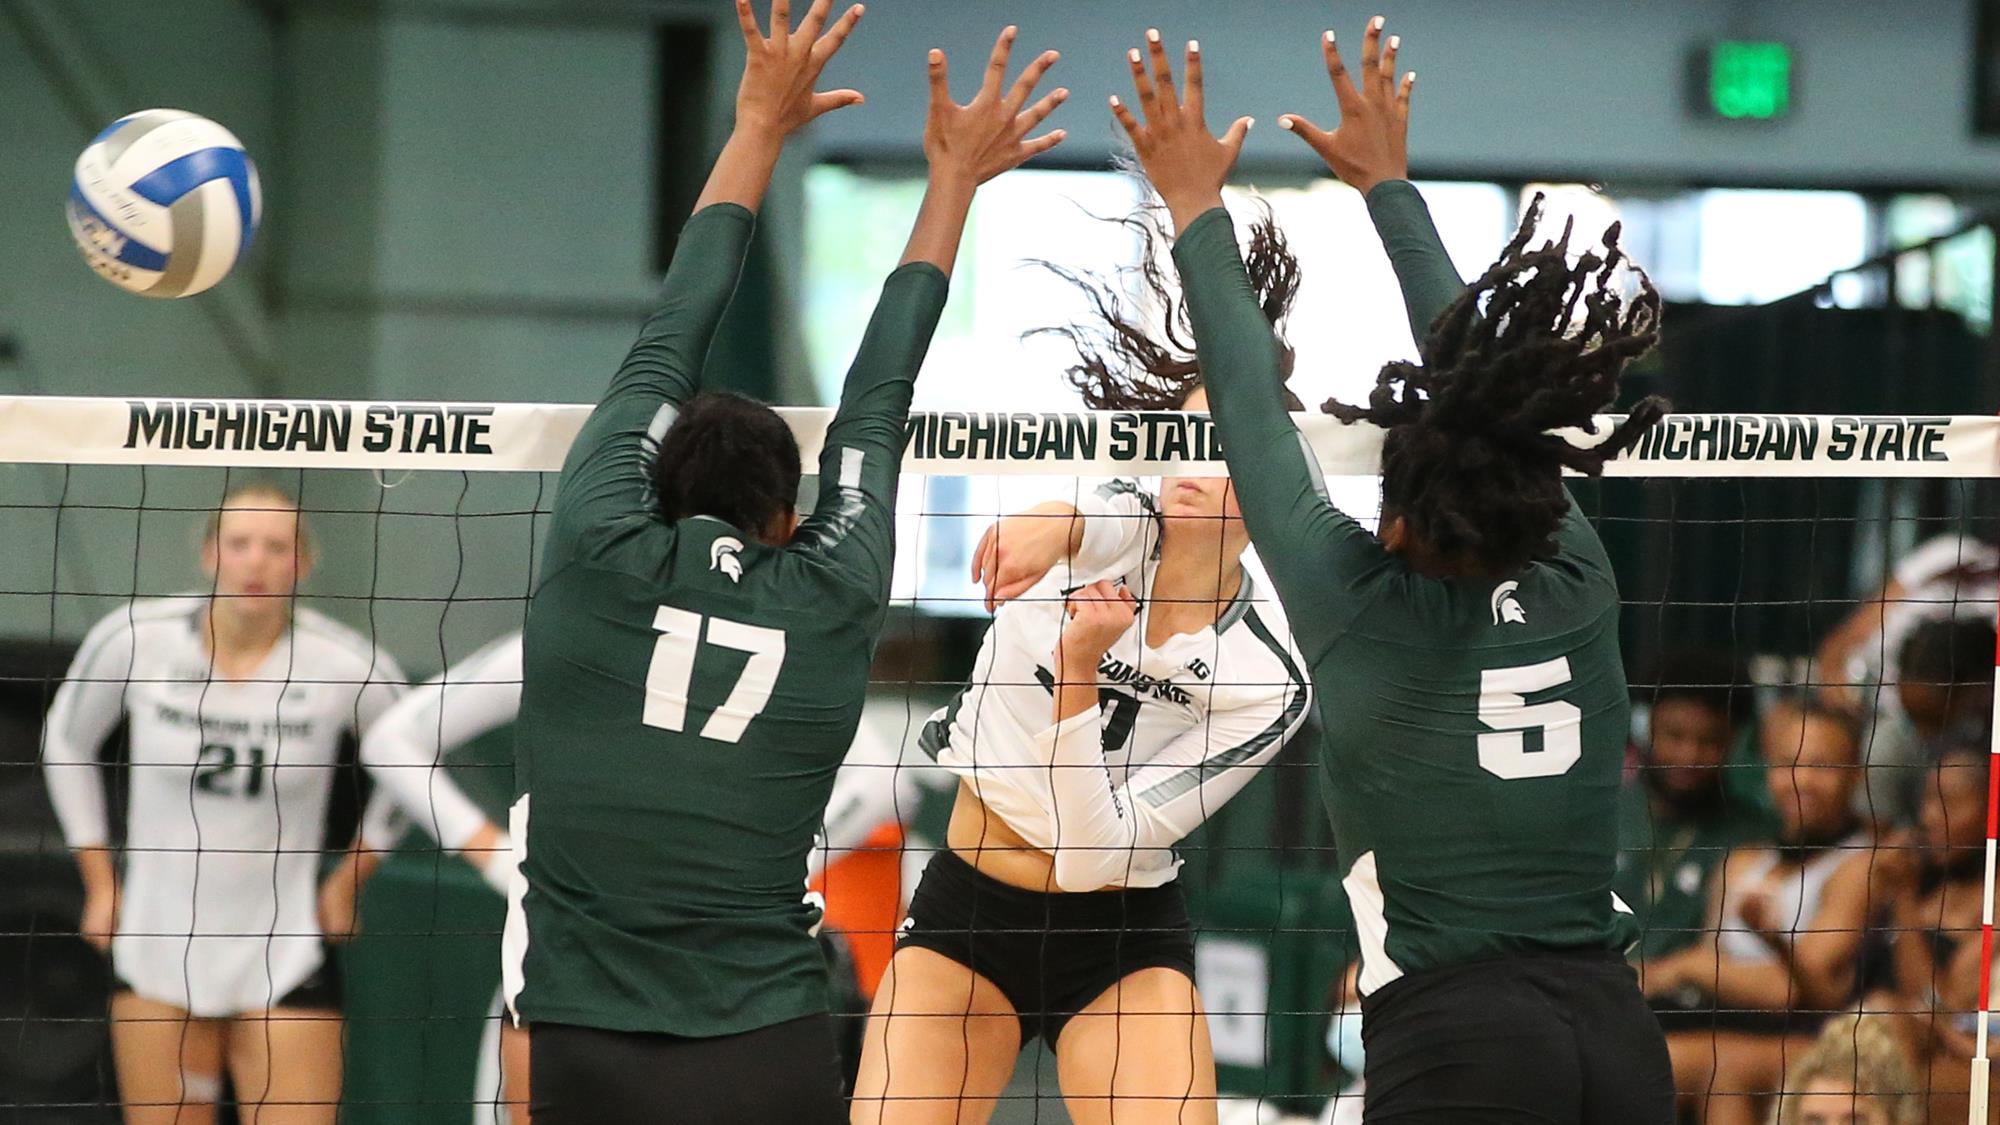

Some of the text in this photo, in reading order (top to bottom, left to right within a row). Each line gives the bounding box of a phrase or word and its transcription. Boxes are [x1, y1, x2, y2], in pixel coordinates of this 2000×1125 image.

[123, 400, 495, 455] MICHIGAN STATE
[1826, 416, 1952, 462] STATE
[642, 604, 786, 744] 17
[1477, 655, 1582, 780] 5
[196, 743, 264, 797] 21
